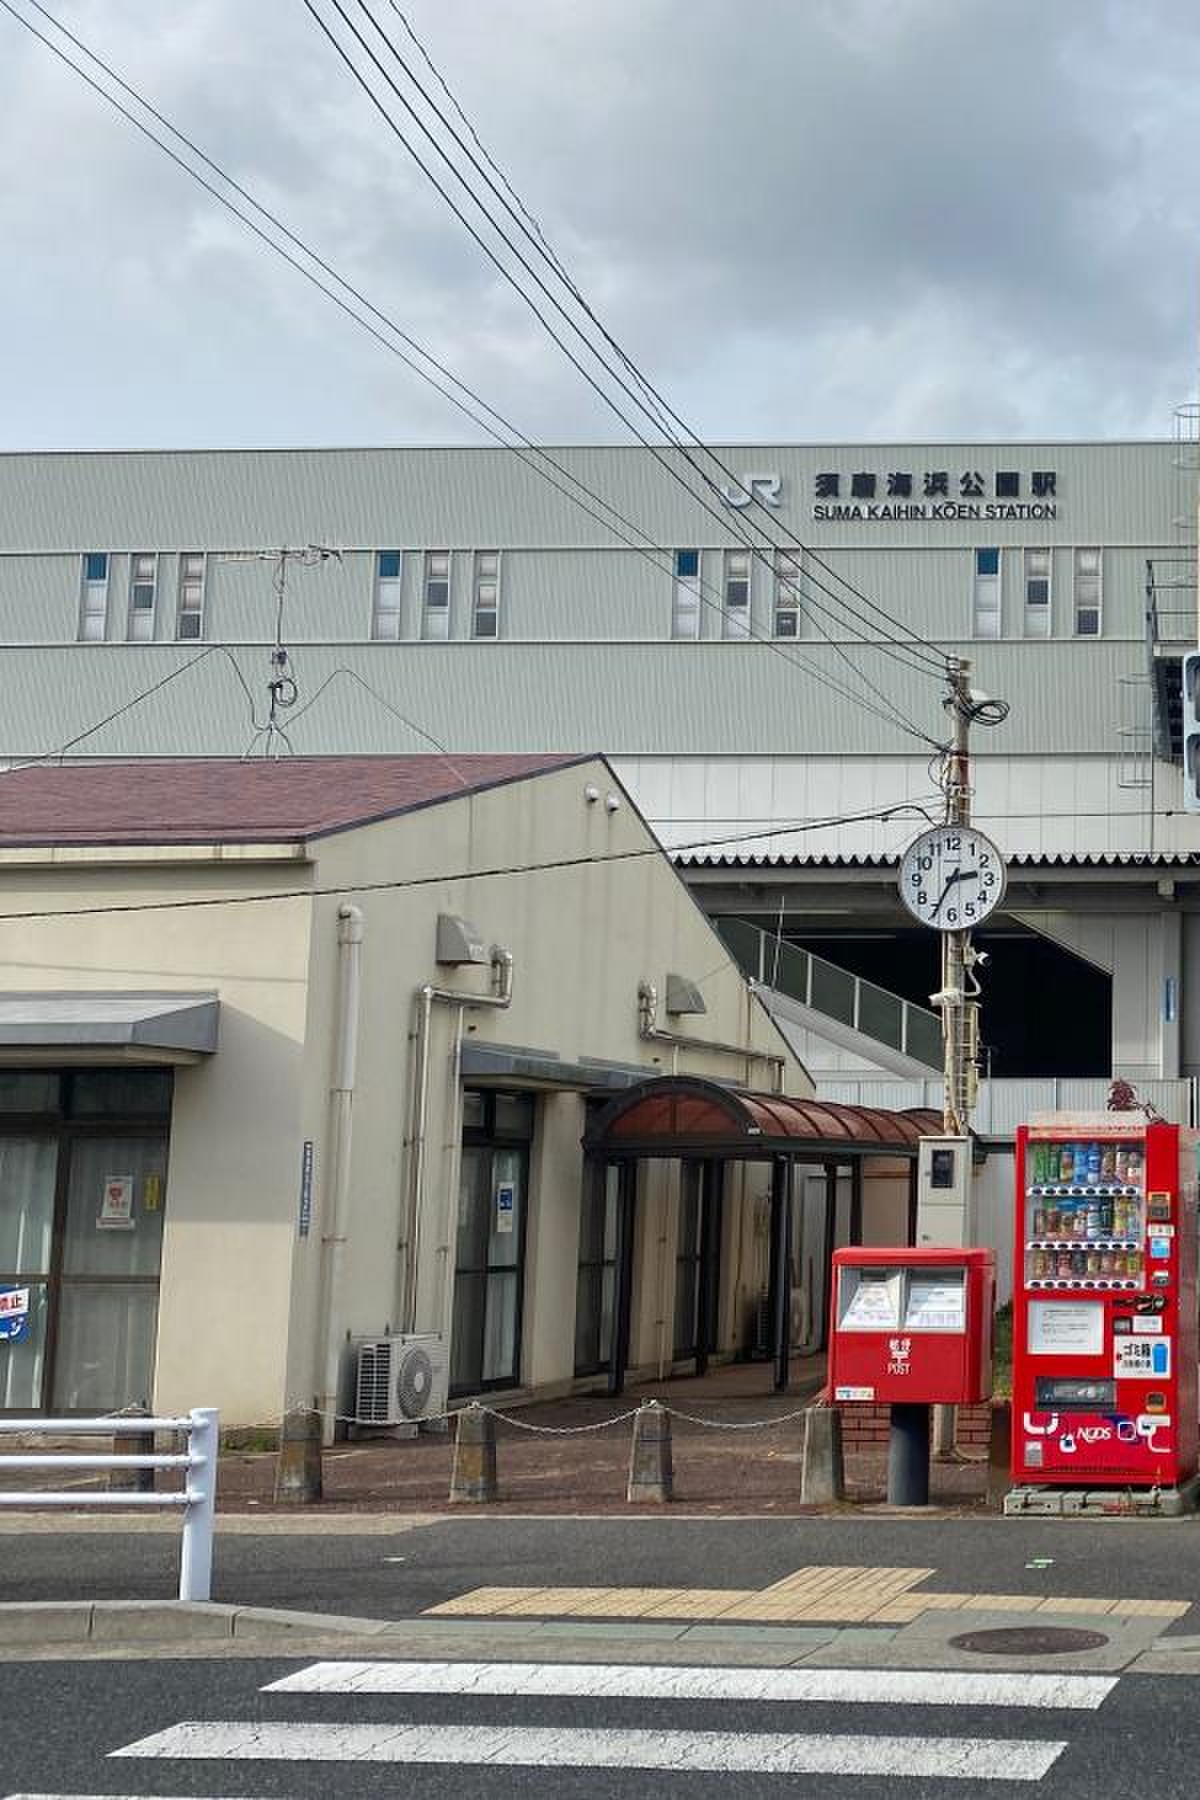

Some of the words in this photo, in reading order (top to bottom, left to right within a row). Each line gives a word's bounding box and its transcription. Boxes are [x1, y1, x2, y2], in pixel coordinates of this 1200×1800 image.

[720, 474, 783, 507] JR
[813, 504, 863, 520] SUMA
[867, 504, 927, 520] KAIHIN
[985, 504, 1057, 520] STATION
[929, 843, 941, 856] 11
[944, 837, 961, 850] 12
[979, 854, 990, 868] 2
[911, 873, 922, 887] 9
[984, 872, 995, 886] 3
[977, 890, 987, 903] 4
[947, 907, 957, 922] 6
[965, 902, 975, 916] 5
